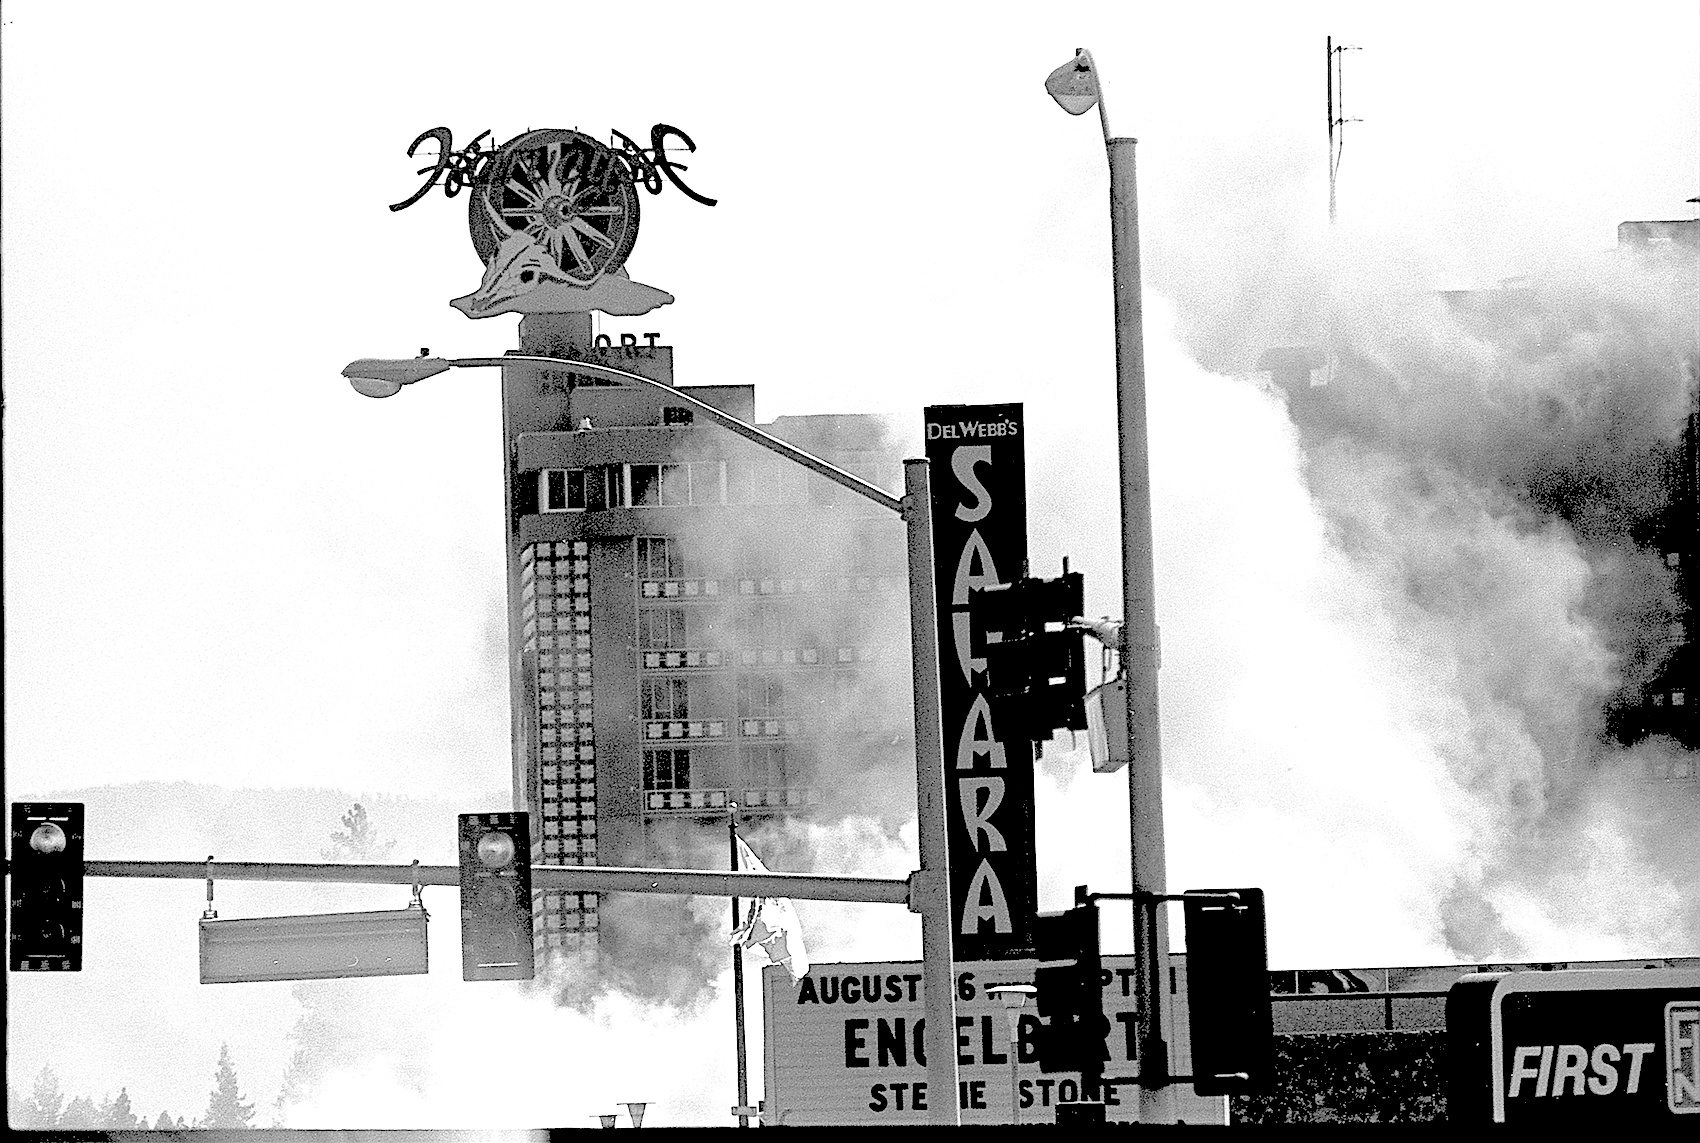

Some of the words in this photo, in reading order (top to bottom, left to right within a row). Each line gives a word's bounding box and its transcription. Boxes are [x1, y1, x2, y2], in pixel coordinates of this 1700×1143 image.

[797, 974, 922, 1005] AUGUST
[844, 1011, 1140, 1068] ENELBT
[1507, 1042, 1656, 1098] FIRST
[868, 1081, 987, 1112] STEIE
